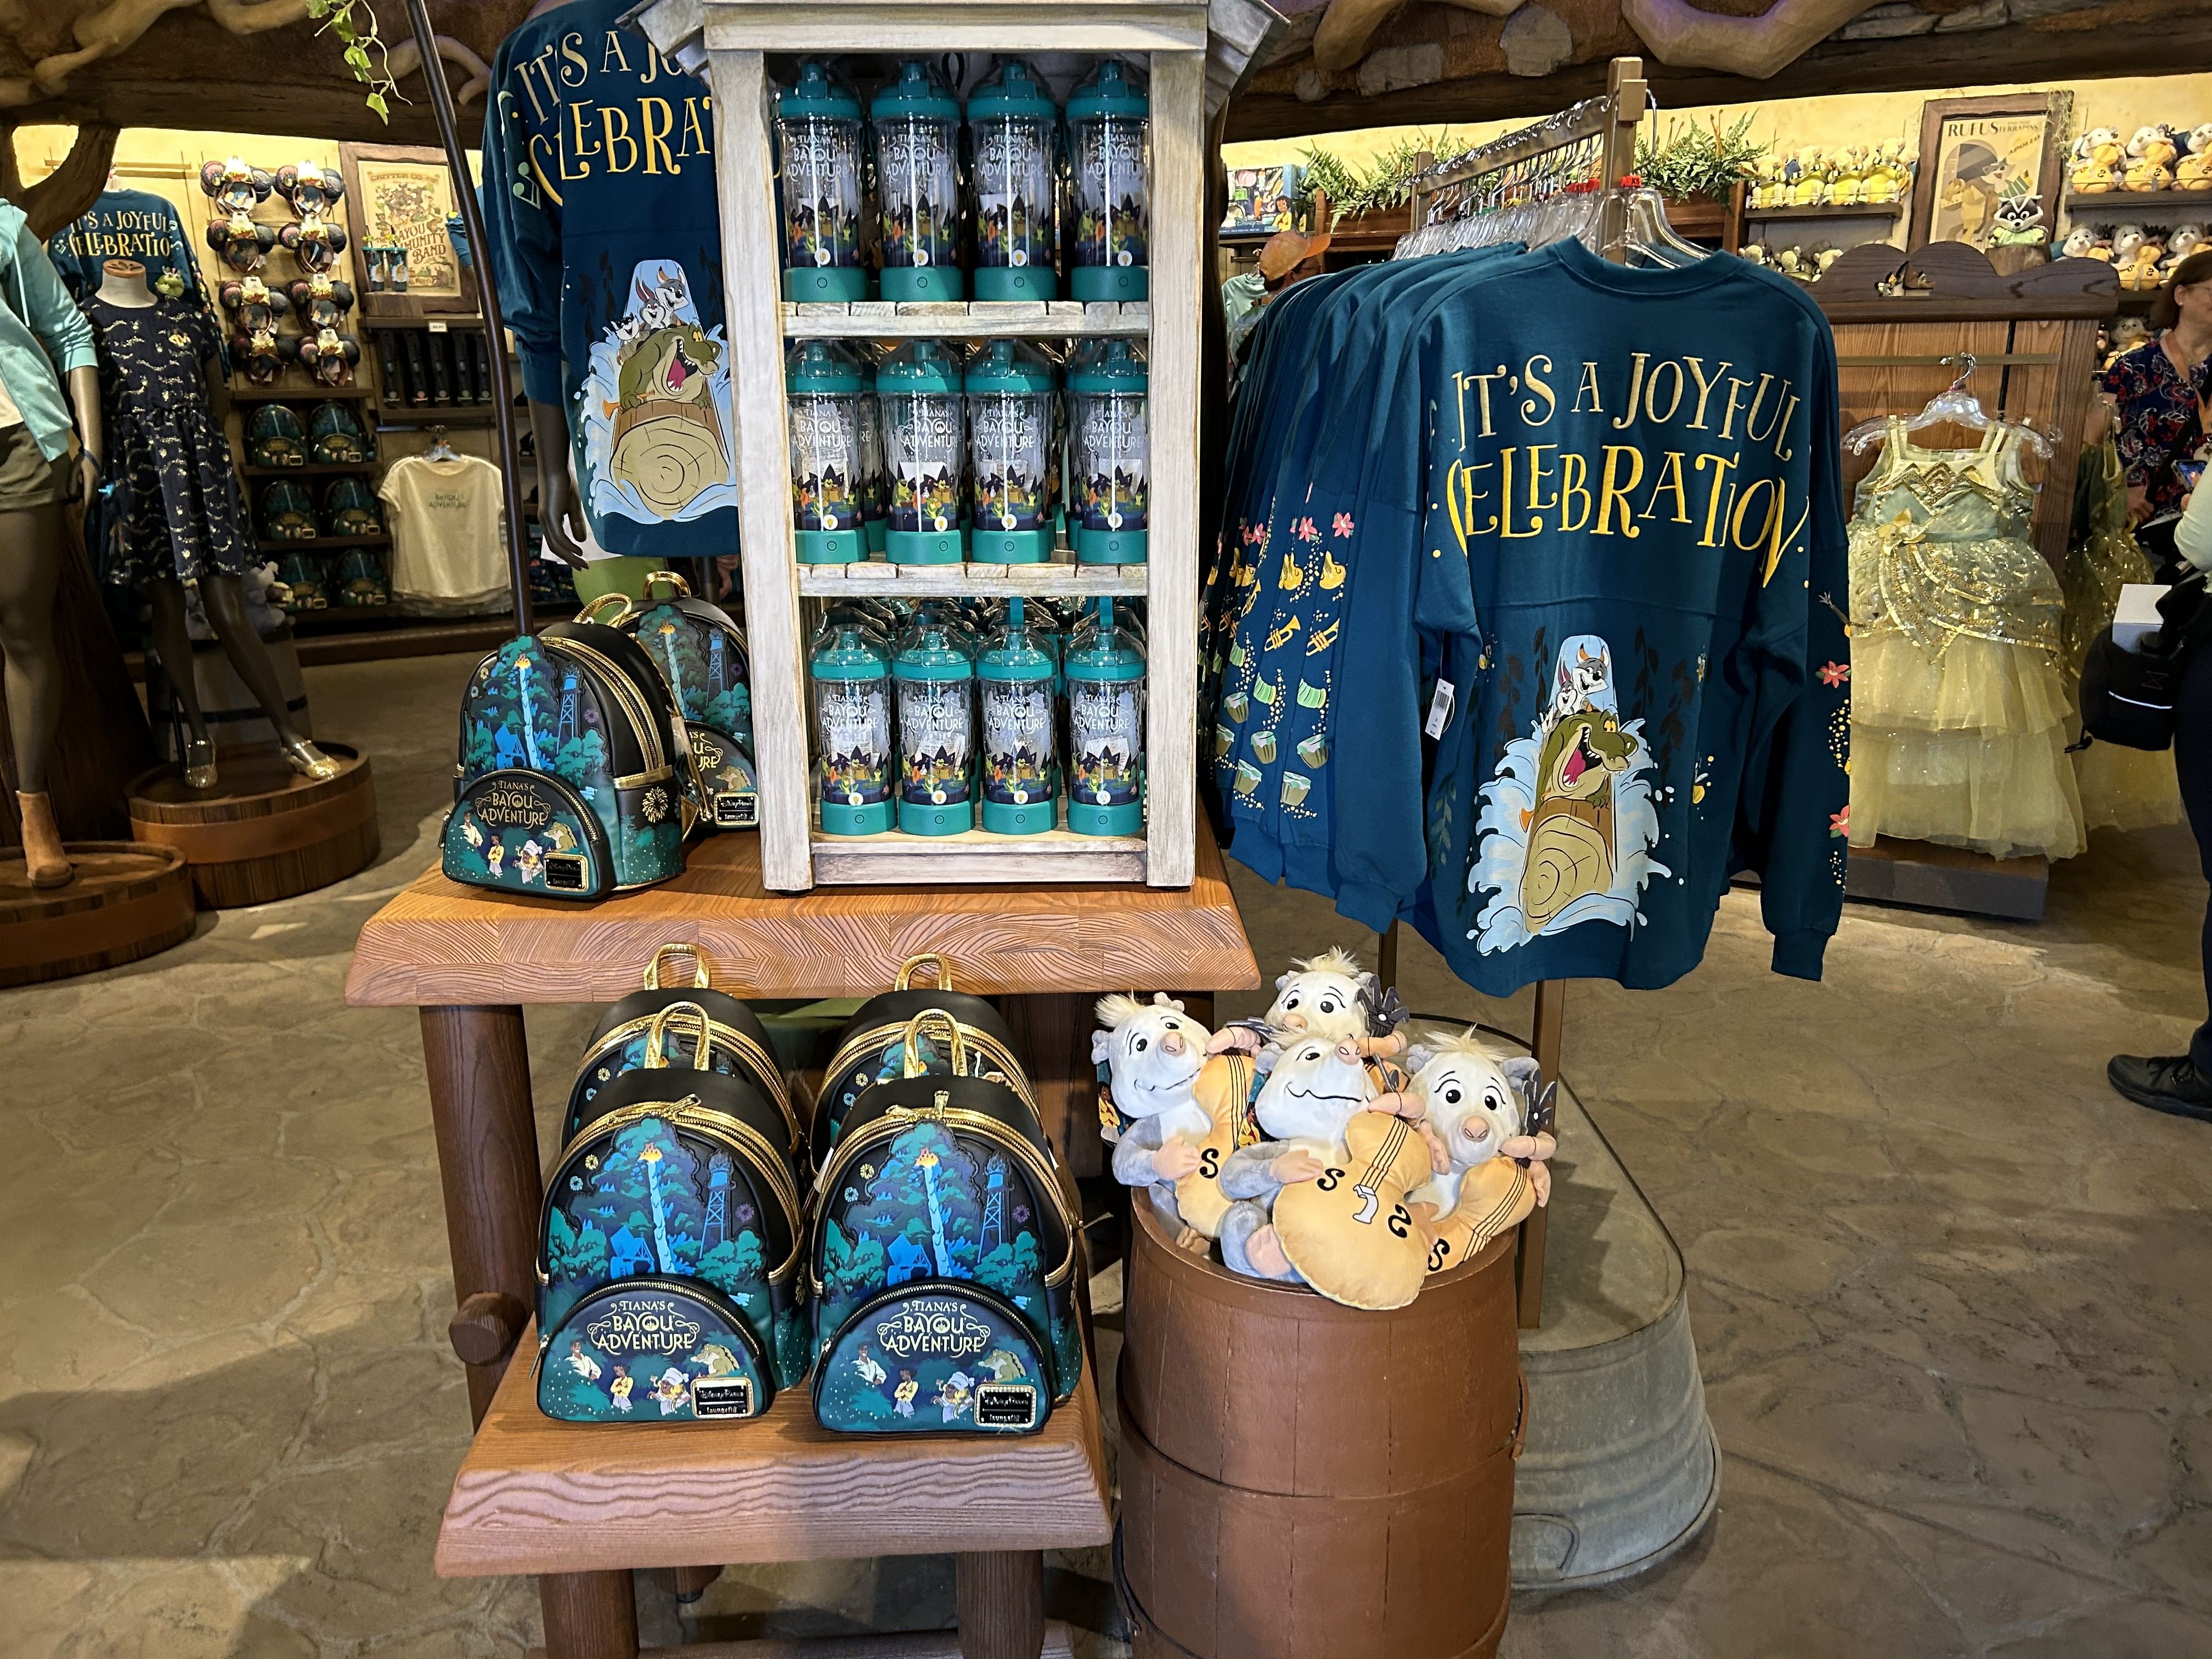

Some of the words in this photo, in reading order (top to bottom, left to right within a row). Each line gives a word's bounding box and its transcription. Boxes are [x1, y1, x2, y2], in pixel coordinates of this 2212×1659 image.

[515, 32, 588, 126] IT'S
[600, 30, 632, 72] A
[1948, 121, 1999, 137] RUFUS
[529, 97, 712, 207] CLEBRA
[103, 213, 114, 227] A
[116, 211, 168, 233] JOYFUL
[399, 223, 425, 241] AYOU
[68, 232, 171, 261] CELEBRATIO
[413, 244, 446, 264] BAND
[804, 409, 836, 417] TINA'S
[1452, 354, 1556, 452] IT'S
[1571, 362, 1604, 413] A
[1613, 352, 1801, 461] JOYFUL
[1447, 444, 1809, 589] CELEBRATION
[833, 694, 863, 703] TIANA'S
[919, 695, 950, 703] TIANA'S
[1001, 695, 1031, 703] TIANA'S
[1085, 694, 1115, 703] TIANA'S
[828, 703, 867, 718] BAYOU
[915, 703, 955, 718] BAYOU
[996, 703, 1035, 718] BAYOU
[1081, 703, 1119, 718] BAYOU
[906, 717, 963, 733] ADVENTURE
[989, 716, 1045, 735] ADVENTURE
[1074, 716, 1130, 735] ADVENTURE
[498, 780, 529, 791] TIANA'S
[492, 791, 534, 809] BAYOU
[481, 808, 545, 830] ADVENTURE
[619, 1300, 666, 1311] TIANA'S
[911, 1300, 958, 1313] TIANA'S
[613, 1312, 674, 1333] BAYOU
[904, 1313, 967, 1335] BAYOU
[597, 1333, 694, 1356] ADVENTURE
[885, 1335, 981, 1358] ADVENTURE
